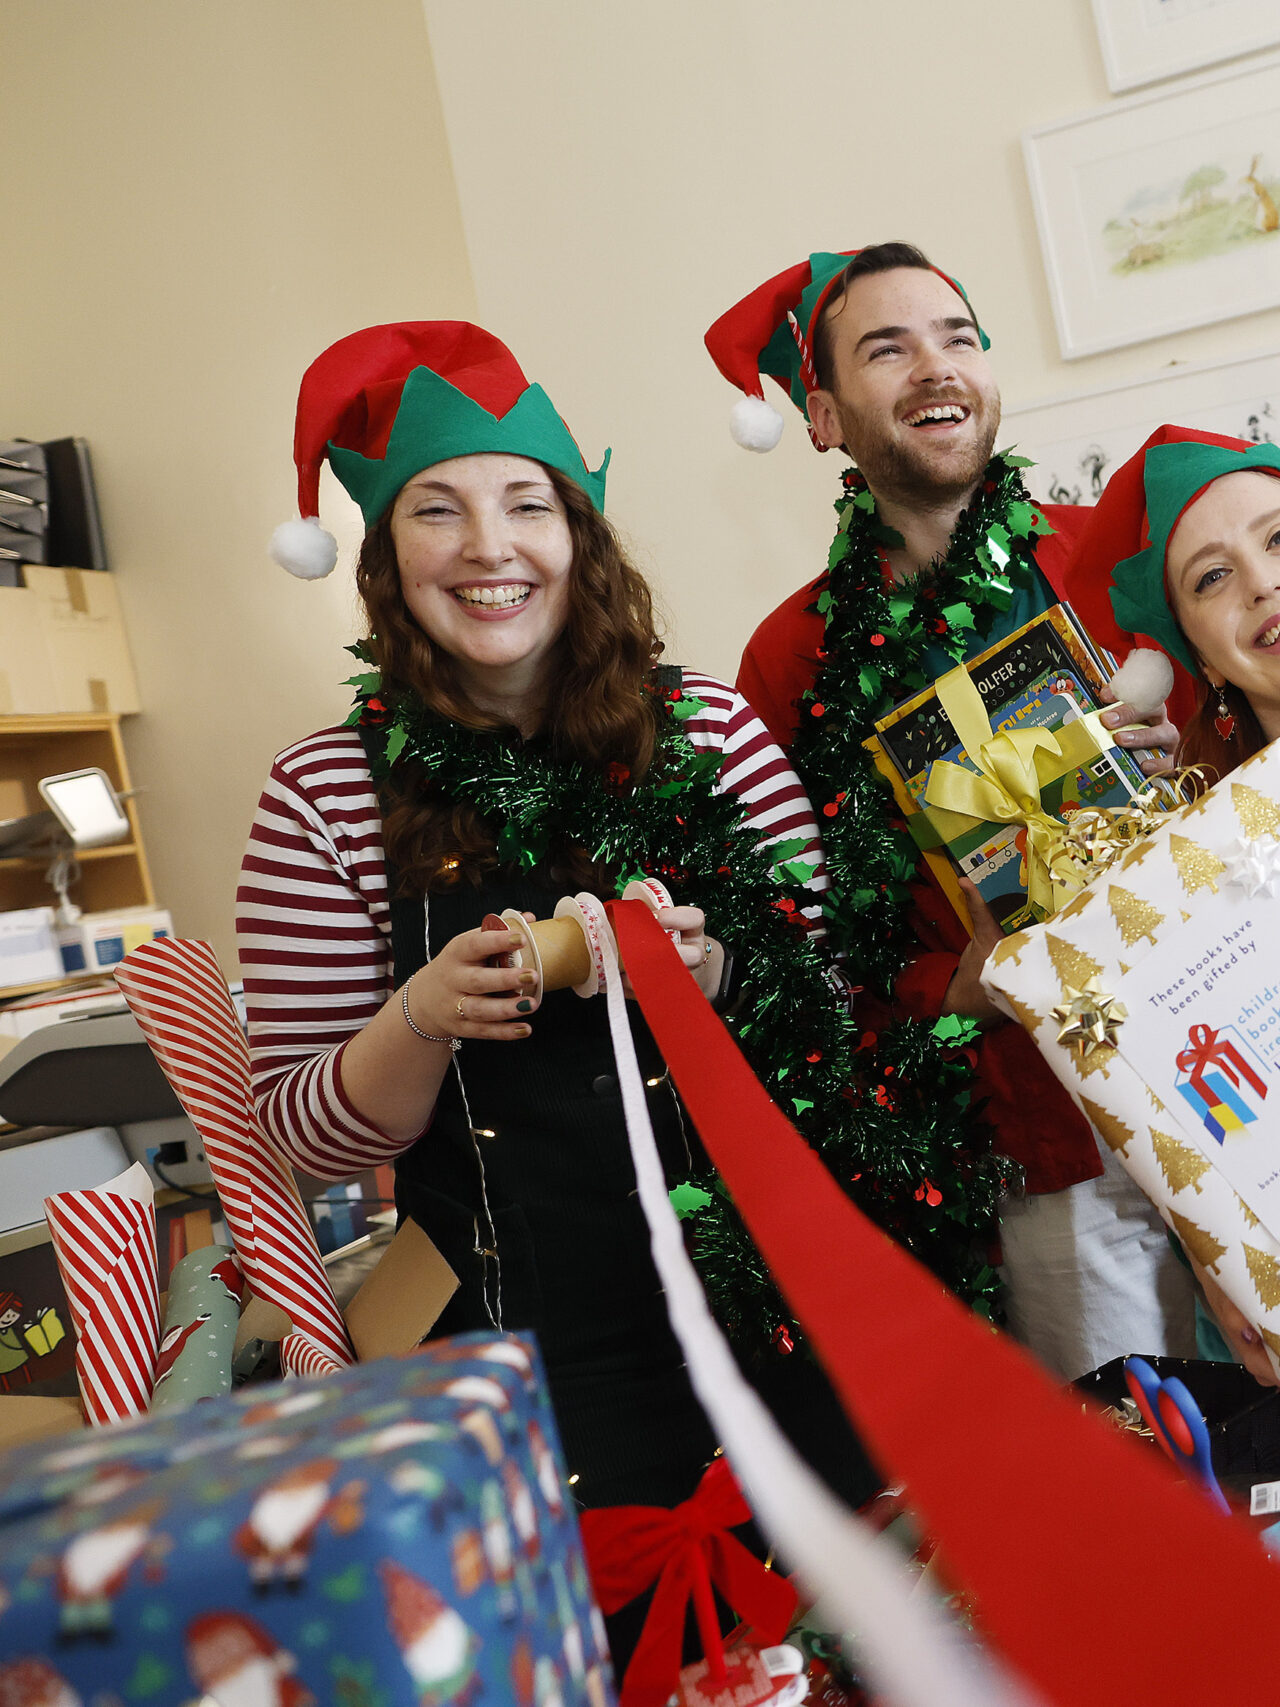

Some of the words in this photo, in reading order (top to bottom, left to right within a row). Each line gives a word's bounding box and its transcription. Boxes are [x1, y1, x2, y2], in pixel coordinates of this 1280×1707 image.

[977, 662, 1017, 694] OLFER
[1148, 976, 1186, 1009] These
[1186, 945, 1223, 977] books
[1223, 919, 1253, 945] have
[1168, 989, 1200, 1016] been
[1203, 953, 1239, 992] gifted
[1238, 940, 1258, 955] by
